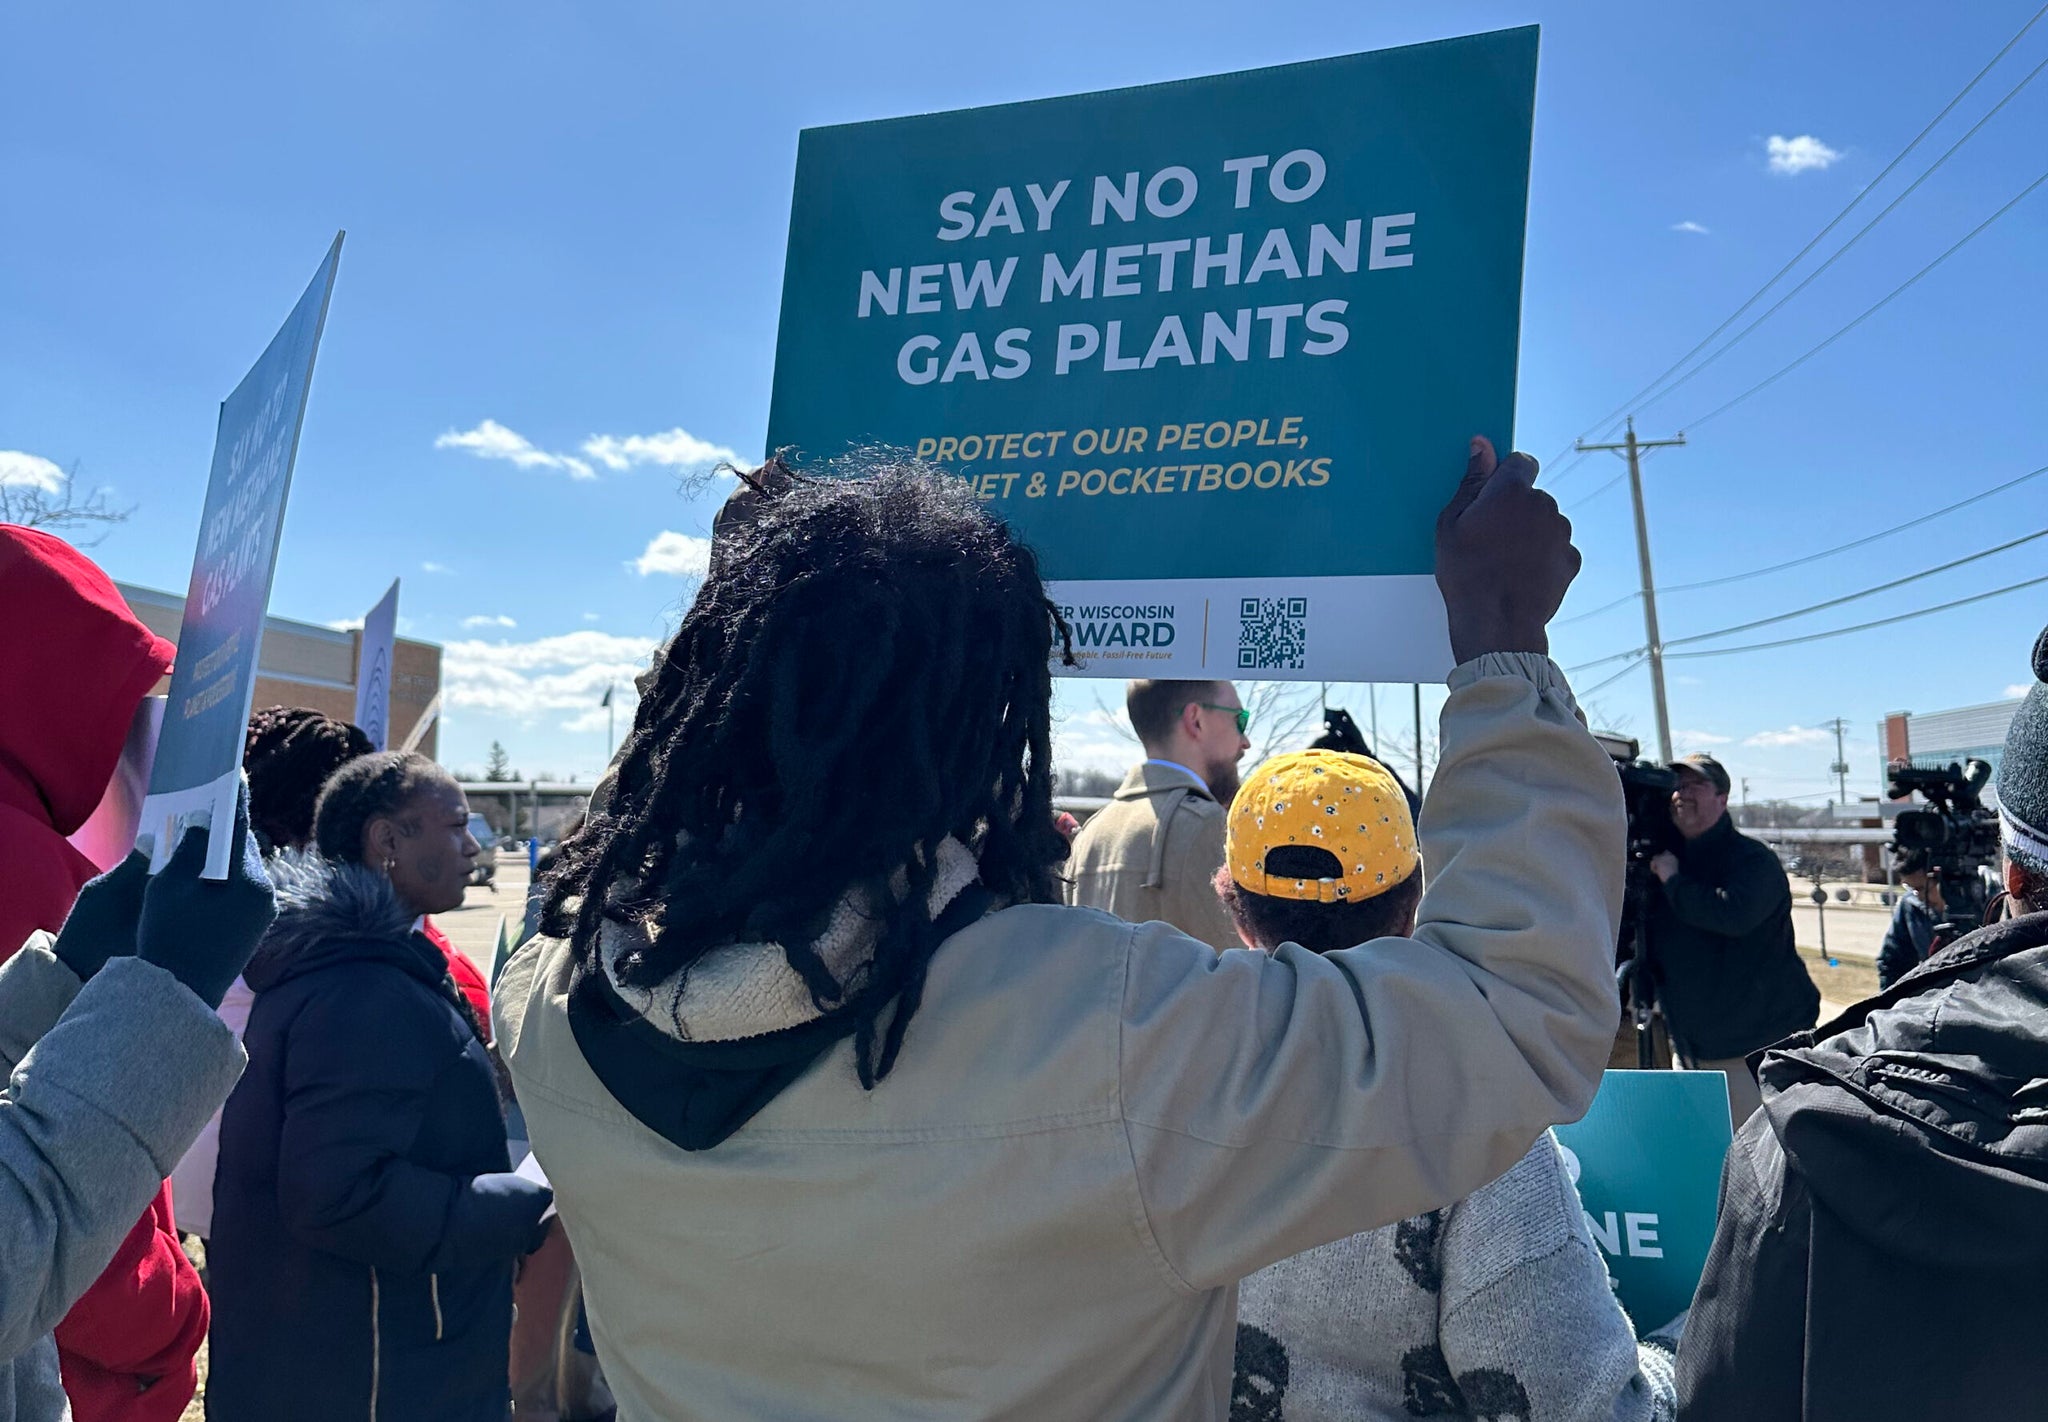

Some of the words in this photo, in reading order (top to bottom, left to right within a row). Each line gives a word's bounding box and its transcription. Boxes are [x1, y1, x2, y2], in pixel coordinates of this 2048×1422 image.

[936, 179, 1071, 241] SAY
[1090, 165, 1199, 226] NO
[1222, 148, 1327, 209] TO
[857, 256, 1019, 318] NEW
[1040, 212, 1416, 303] METHANE
[896, 327, 1032, 386] GAS
[1055, 298, 1350, 375] PLANTS
[915, 430, 1067, 462] PROTECT
[1072, 426, 1149, 456] OUR
[1156, 416, 1309, 452] PEOPLE,
[959, 472, 1020, 499] NET
[1025, 471, 1048, 498] &
[1056, 457, 1333, 497] POCKETBOOKS
[1079, 605, 1175, 619] WISCONSIN
[1145, 650, 1173, 659] Future
